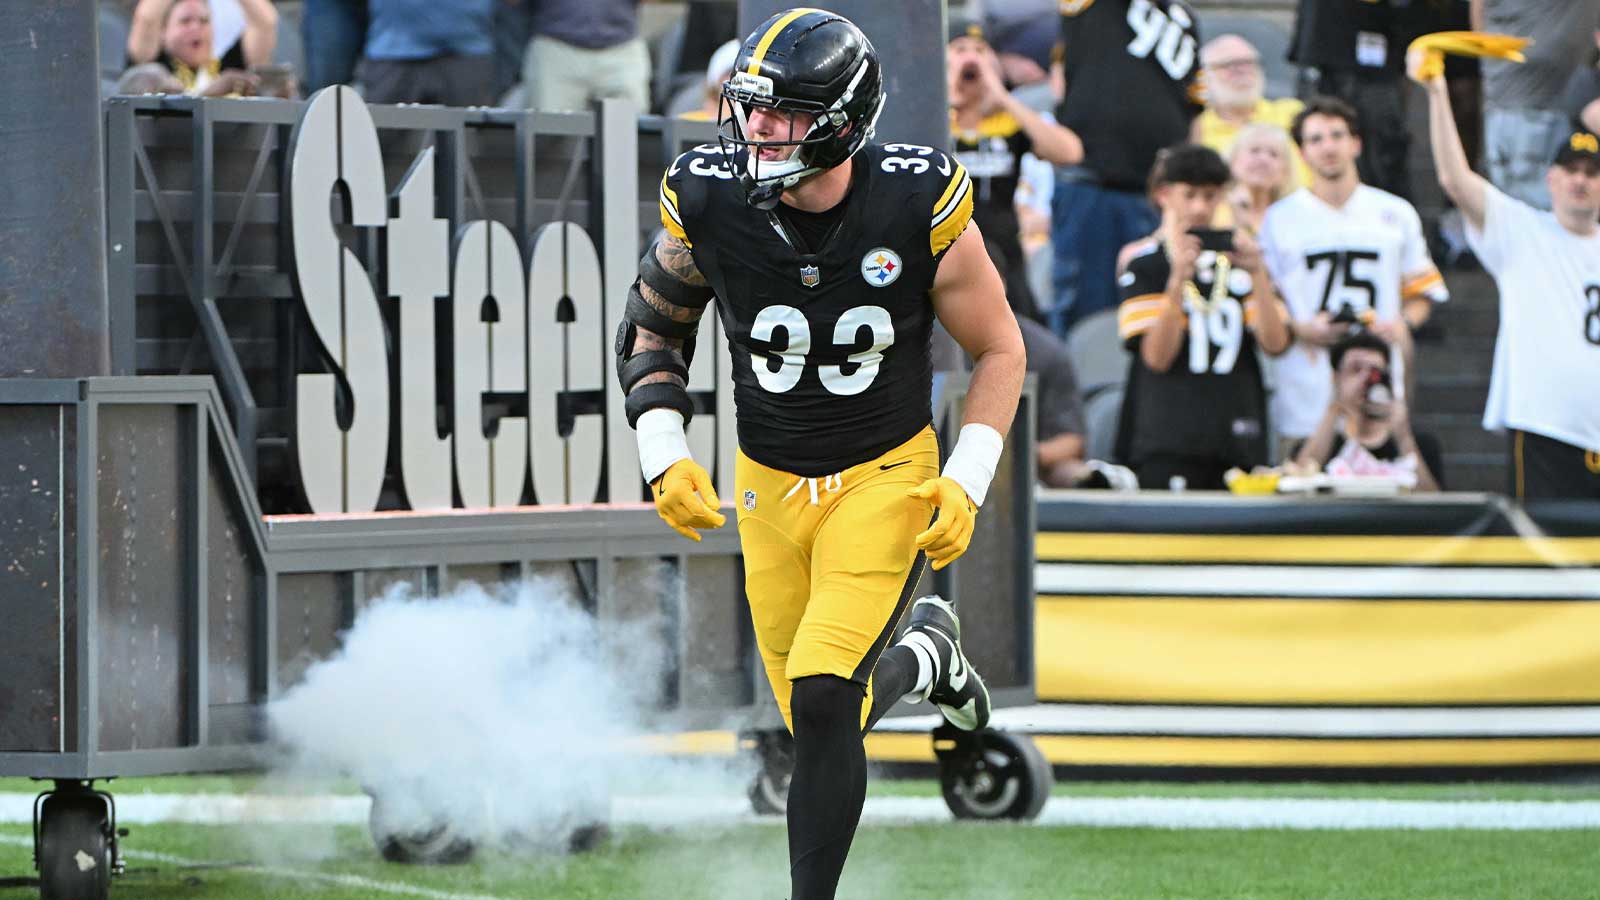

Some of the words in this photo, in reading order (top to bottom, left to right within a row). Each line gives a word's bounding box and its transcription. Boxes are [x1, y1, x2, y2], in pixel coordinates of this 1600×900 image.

[1126, 0, 1196, 80] 90
[881, 143, 934, 174] 33
[290, 84, 738, 514] Steel
[1306, 250, 1379, 312] 75
[750, 304, 895, 396] 33
[1183, 297, 1243, 374] 19
